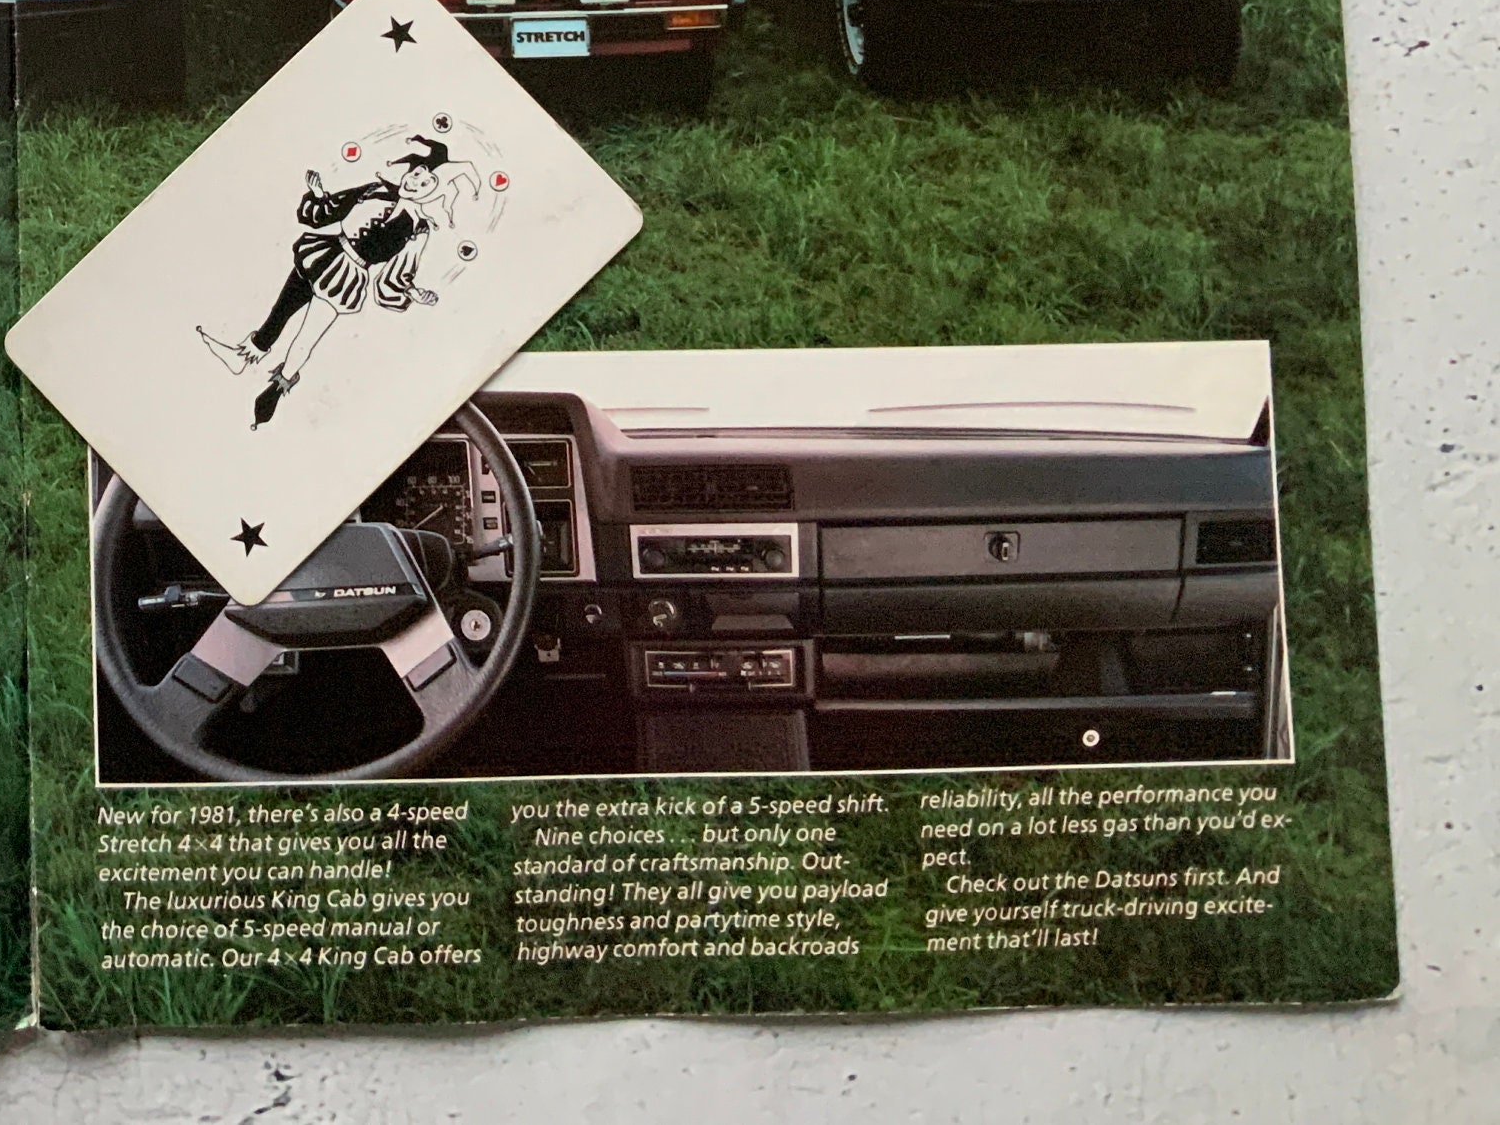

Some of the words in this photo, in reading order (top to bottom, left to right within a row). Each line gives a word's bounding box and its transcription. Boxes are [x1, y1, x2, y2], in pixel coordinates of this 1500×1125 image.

[516, 30, 586, 44] STRETCH
[333, 586, 397, 598] DATSUN
[920, 787, 1022, 812] reliability,
[1028, 787, 1054, 807] all
[1058, 787, 1093, 805] the
[1097, 784, 1234, 809] performance
[1237, 787, 1277, 807] you
[97, 806, 146, 827] New
[150, 804, 183, 825] for
[189, 805, 241, 827] 1981,
[248, 803, 319, 824] there's
[323, 803, 364, 823] also
[369, 807, 382, 822] a
[386, 800, 469, 825] 4-speed
[98, 862, 218, 882] excitement
[221, 866, 262, 886] you
[267, 865, 304, 881] can
[309, 859, 392, 880] handle!
[513, 853, 607, 876] standard
[612, 852, 637, 873] of
[639, 851, 795, 876] craftsmanship.
[802, 851, 850, 871] Out-
[516, 912, 625, 937] toughness
[629, 909, 671, 930] and
[674, 911, 781, 934] partytime
[786, 908, 840, 933] style,
[925, 904, 968, 928] give
[972, 899, 1060, 927] yourself
[1062, 897, 1198, 920] truck-driving
[1203, 896, 1274, 915] excite-
[517, 940, 609, 966] highway
[613, 937, 700, 958] comfort
[703, 937, 746, 956] and
[750, 935, 860, 957] backroads
[926, 933, 982, 952] ment
[986, 928, 1050, 950] that'll
[1054, 927, 1098, 947] last!
[101, 947, 214, 970] automatic.
[221, 948, 263, 968] Our
[317, 946, 367, 970] King
[373, 945, 414, 965] Cab
[419, 944, 482, 965] offers
